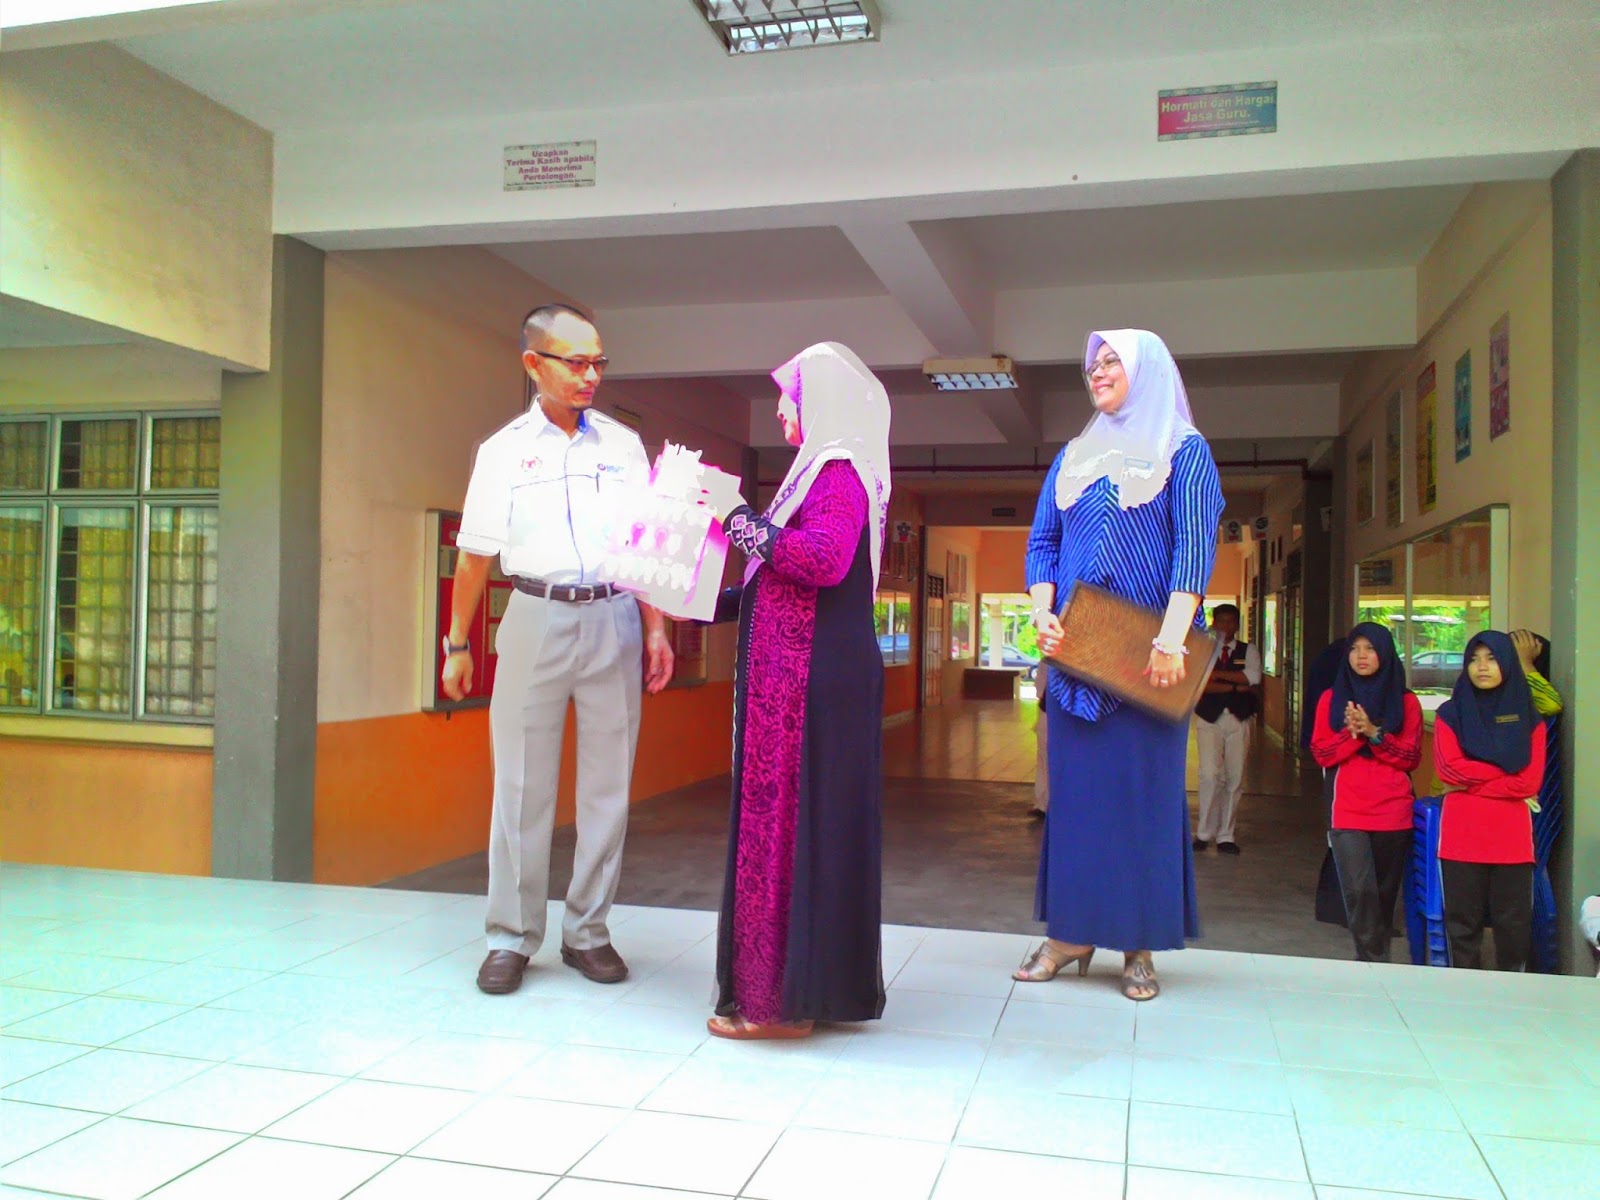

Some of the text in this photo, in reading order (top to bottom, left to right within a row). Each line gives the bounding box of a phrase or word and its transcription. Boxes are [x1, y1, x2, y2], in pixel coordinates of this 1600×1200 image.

[1161, 94, 1274, 112] Hormati dan Hargai
[1183, 108, 1251, 123] Jasa Guru.
[531, 149, 569, 157] Ucapkan
[537, 157, 561, 165] Kasih
[563, 155, 594, 164] apabila
[541, 164, 582, 172] Menerima
